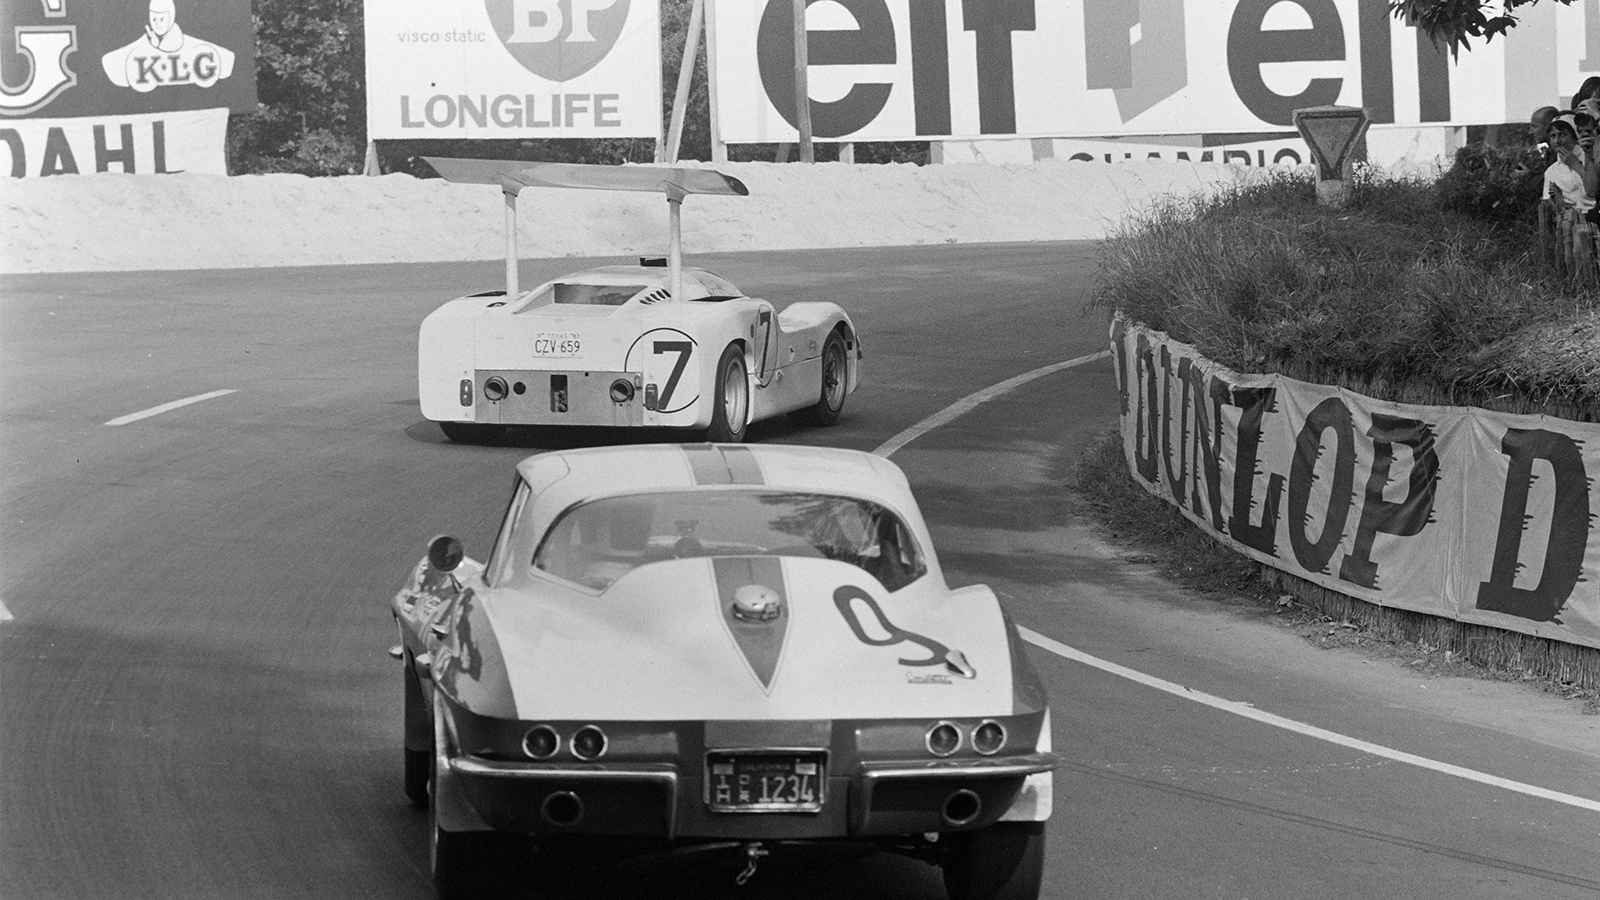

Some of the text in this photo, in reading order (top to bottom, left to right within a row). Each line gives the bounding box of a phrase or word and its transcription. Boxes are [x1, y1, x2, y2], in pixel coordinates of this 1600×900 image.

[400, 93, 622, 128] LONGLIFE
[652, 341, 693, 411] 7
[760, 311, 771, 379] 7
[1133, 333, 1441, 591] DUNLOP
[758, 775, 814, 803] 1234
